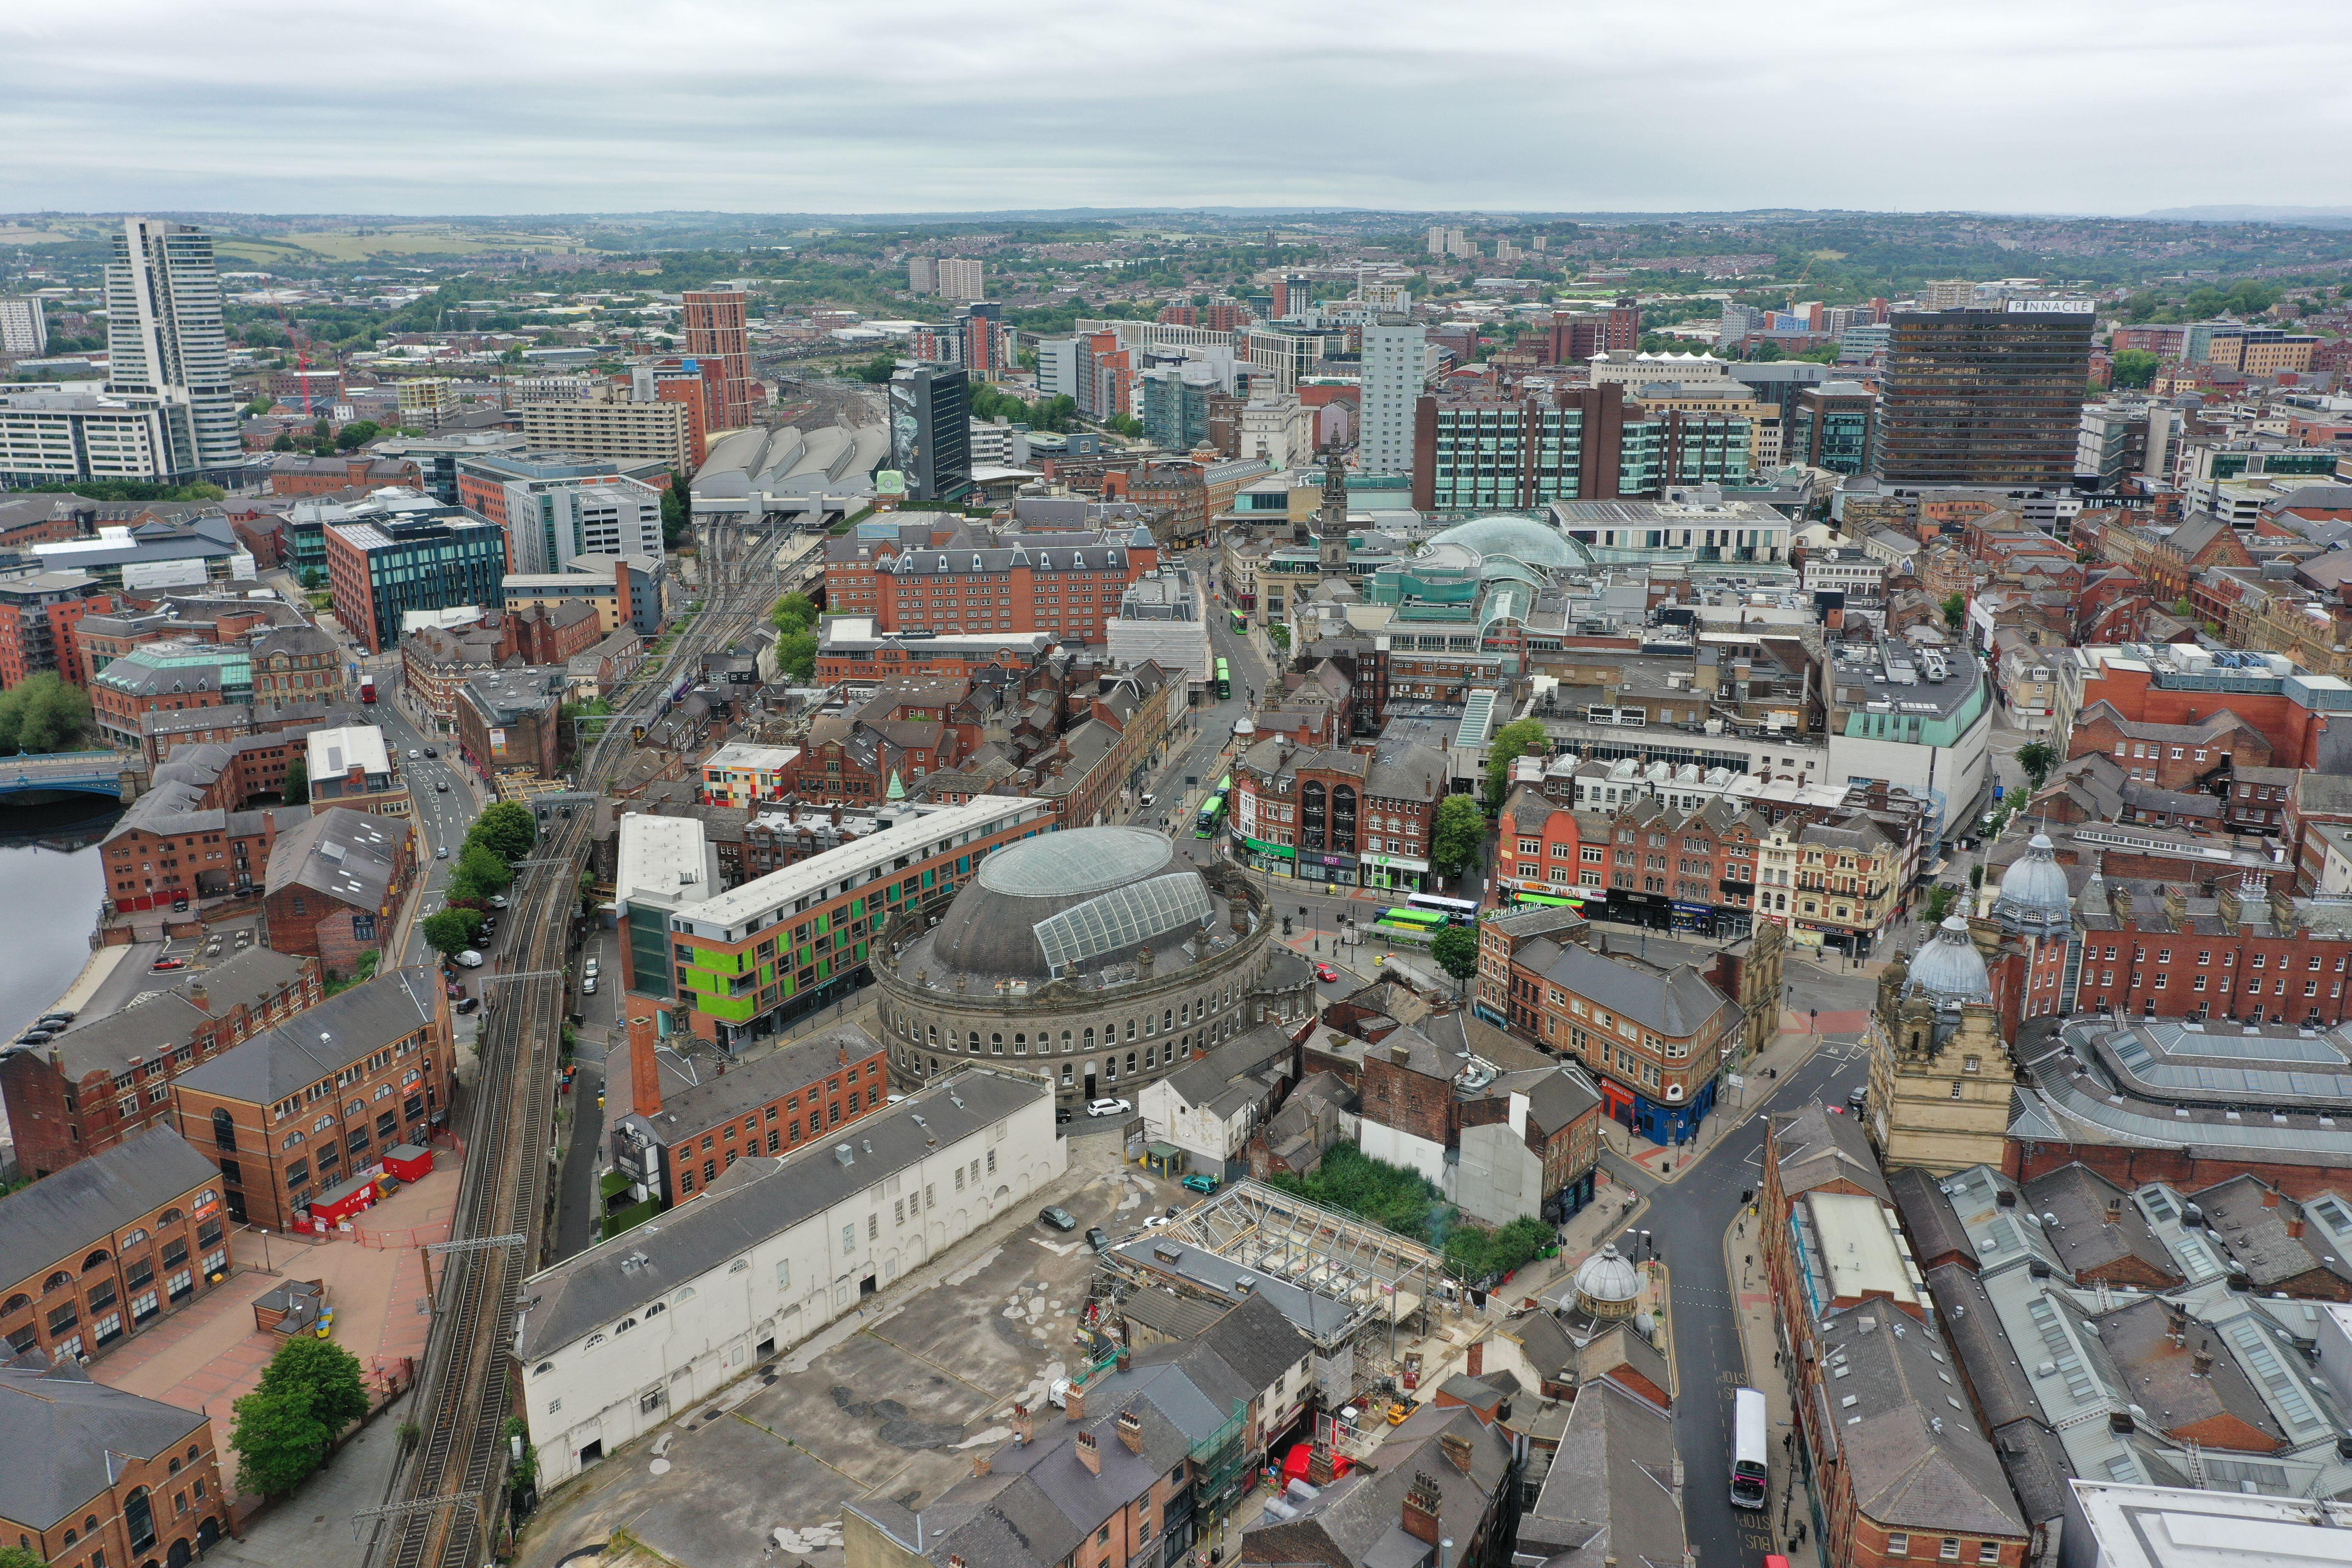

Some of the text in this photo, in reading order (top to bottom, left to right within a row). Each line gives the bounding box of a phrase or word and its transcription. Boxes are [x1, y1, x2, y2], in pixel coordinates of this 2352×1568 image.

[2016, 301, 2088, 312] PINNACLE
[1817, 925, 1842, 934] NOODLE
[1481, 1006, 1504, 1023] BLUE RINSE
[1719, 1372, 1747, 1385] STOP
[1724, 1387, 1737, 1400] US
[1740, 1514, 1770, 1530] STOP
[1746, 1534, 1770, 1551] BUS
